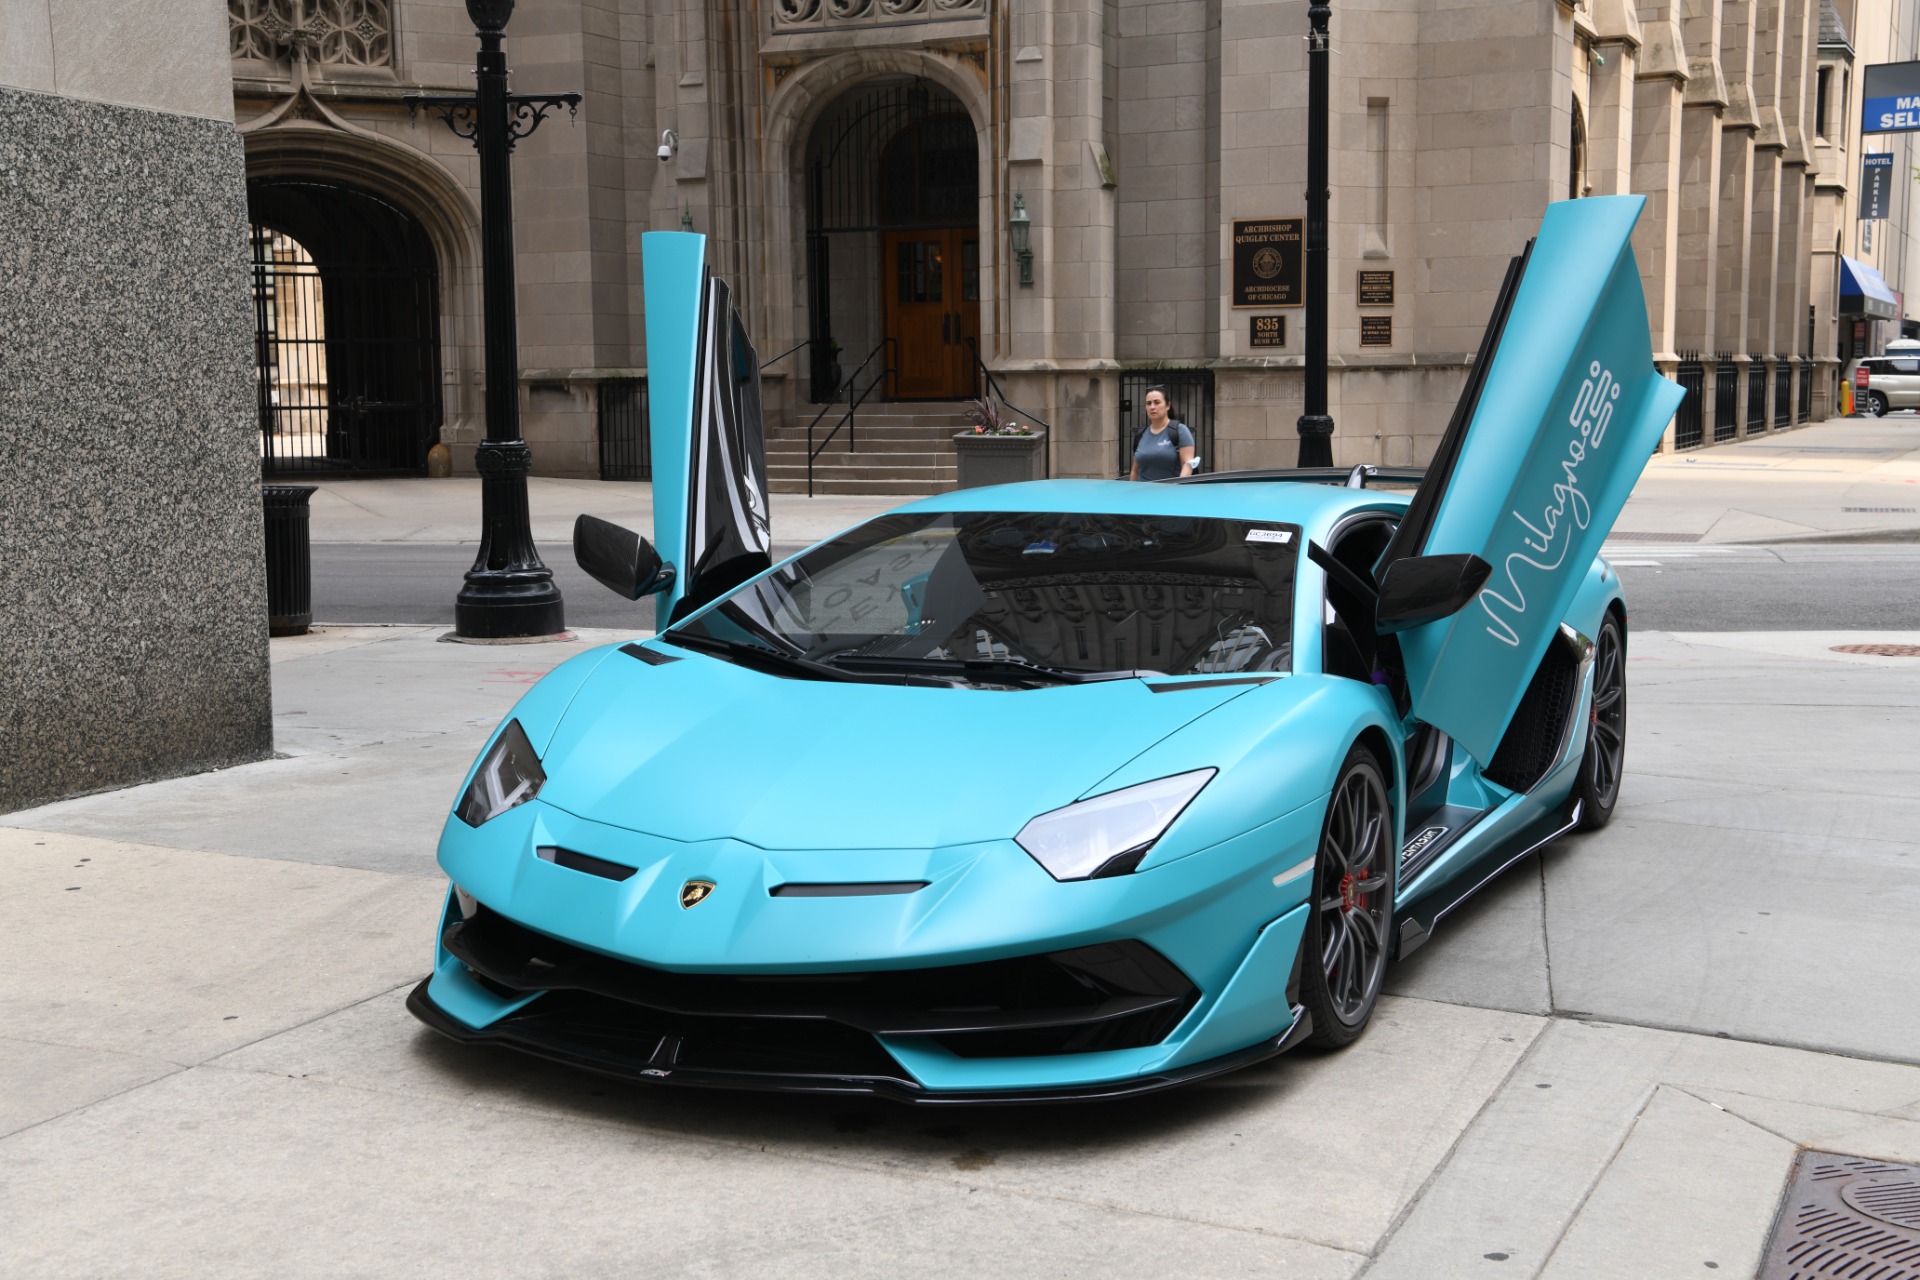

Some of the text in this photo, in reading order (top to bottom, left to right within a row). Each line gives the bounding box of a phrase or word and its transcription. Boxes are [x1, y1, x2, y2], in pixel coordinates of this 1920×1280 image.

[1880, 111, 1920, 128] SEL
[1871, 168, 1881, 216] PARKING
[1243, 224, 1292, 233] ARCHBISHOP
[1235, 233, 1300, 244] QUIGLEY CENTER
[1256, 318, 1279, 330] 835
[1479, 436, 1591, 647] Milagro
[1400, 830, 1438, 862] VENTADOR
